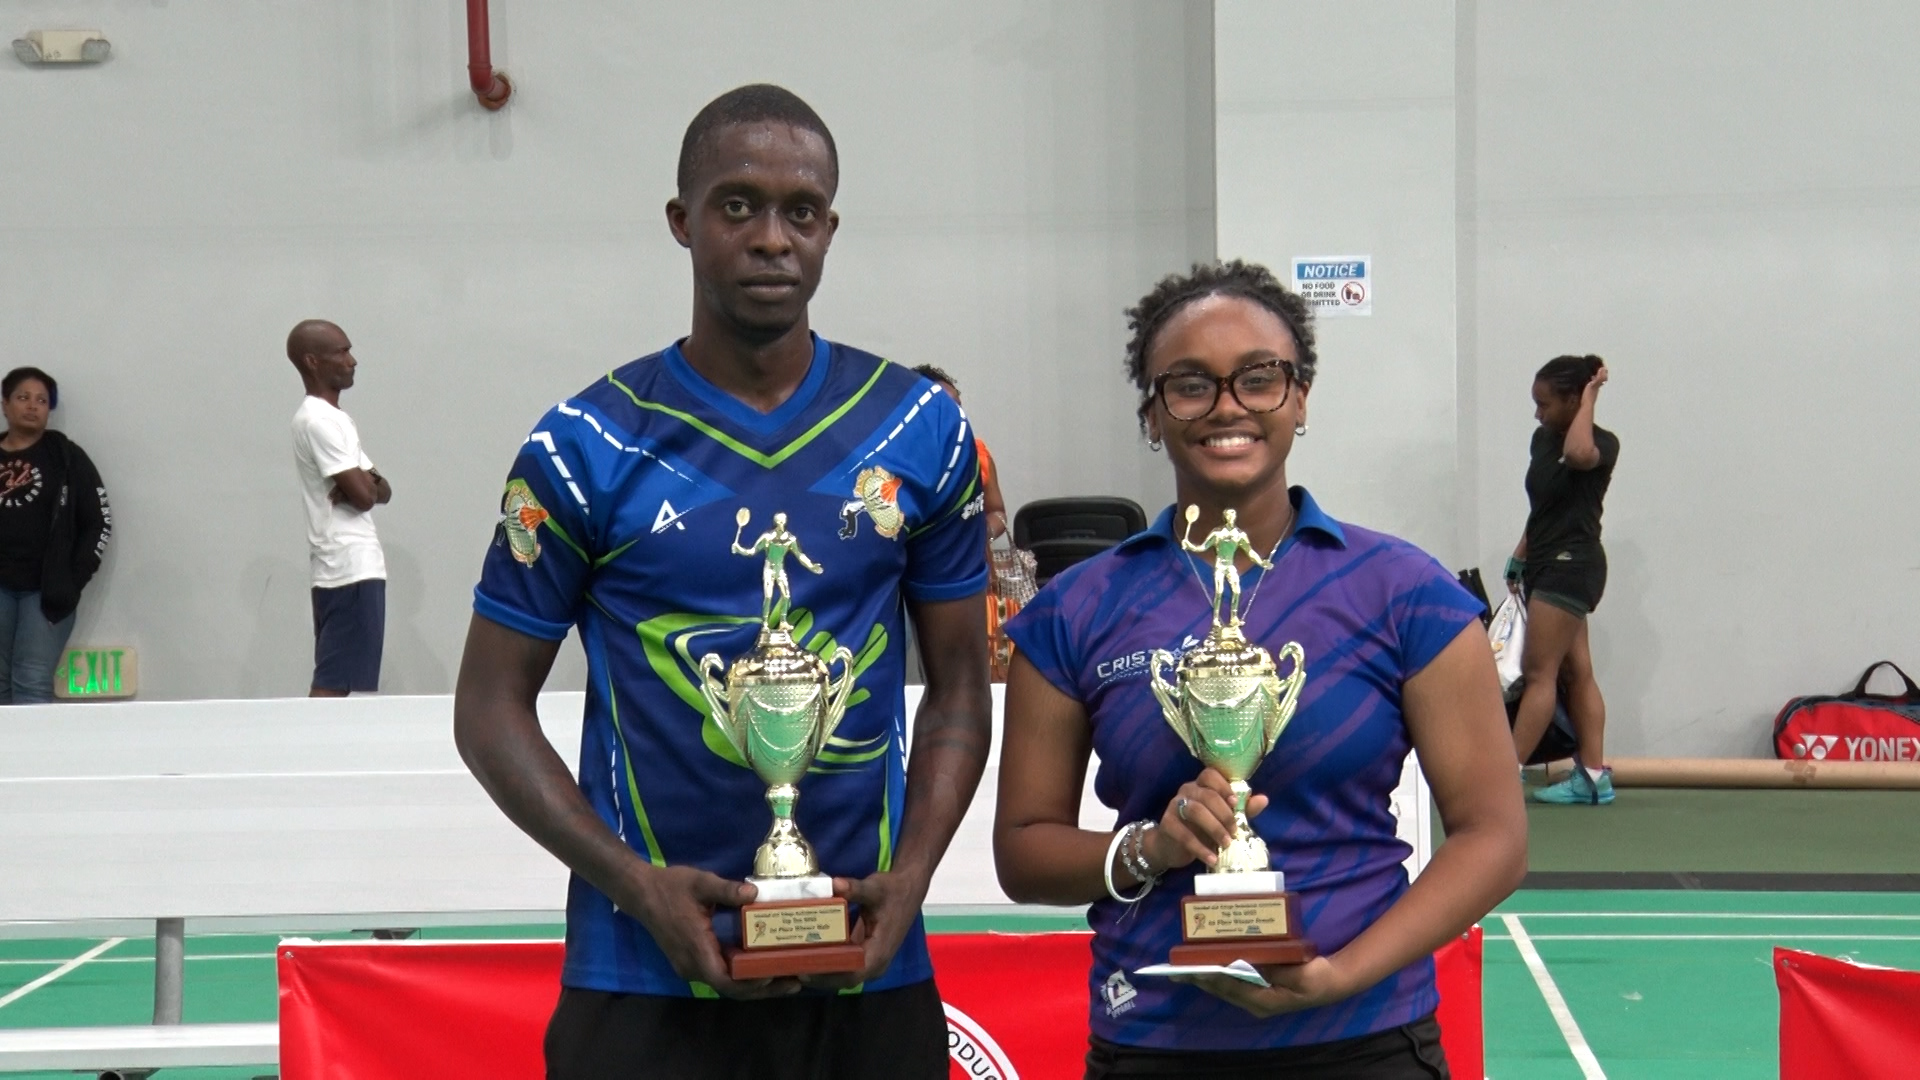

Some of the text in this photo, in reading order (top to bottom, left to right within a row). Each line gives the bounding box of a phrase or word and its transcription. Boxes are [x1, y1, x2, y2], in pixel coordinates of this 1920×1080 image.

[1304, 264, 1358, 278] NOTICE
[1315, 282, 1335, 290] FOOD
[68, 651, 124, 694] EXIT
[1097, 650, 1157, 678] CRIS
